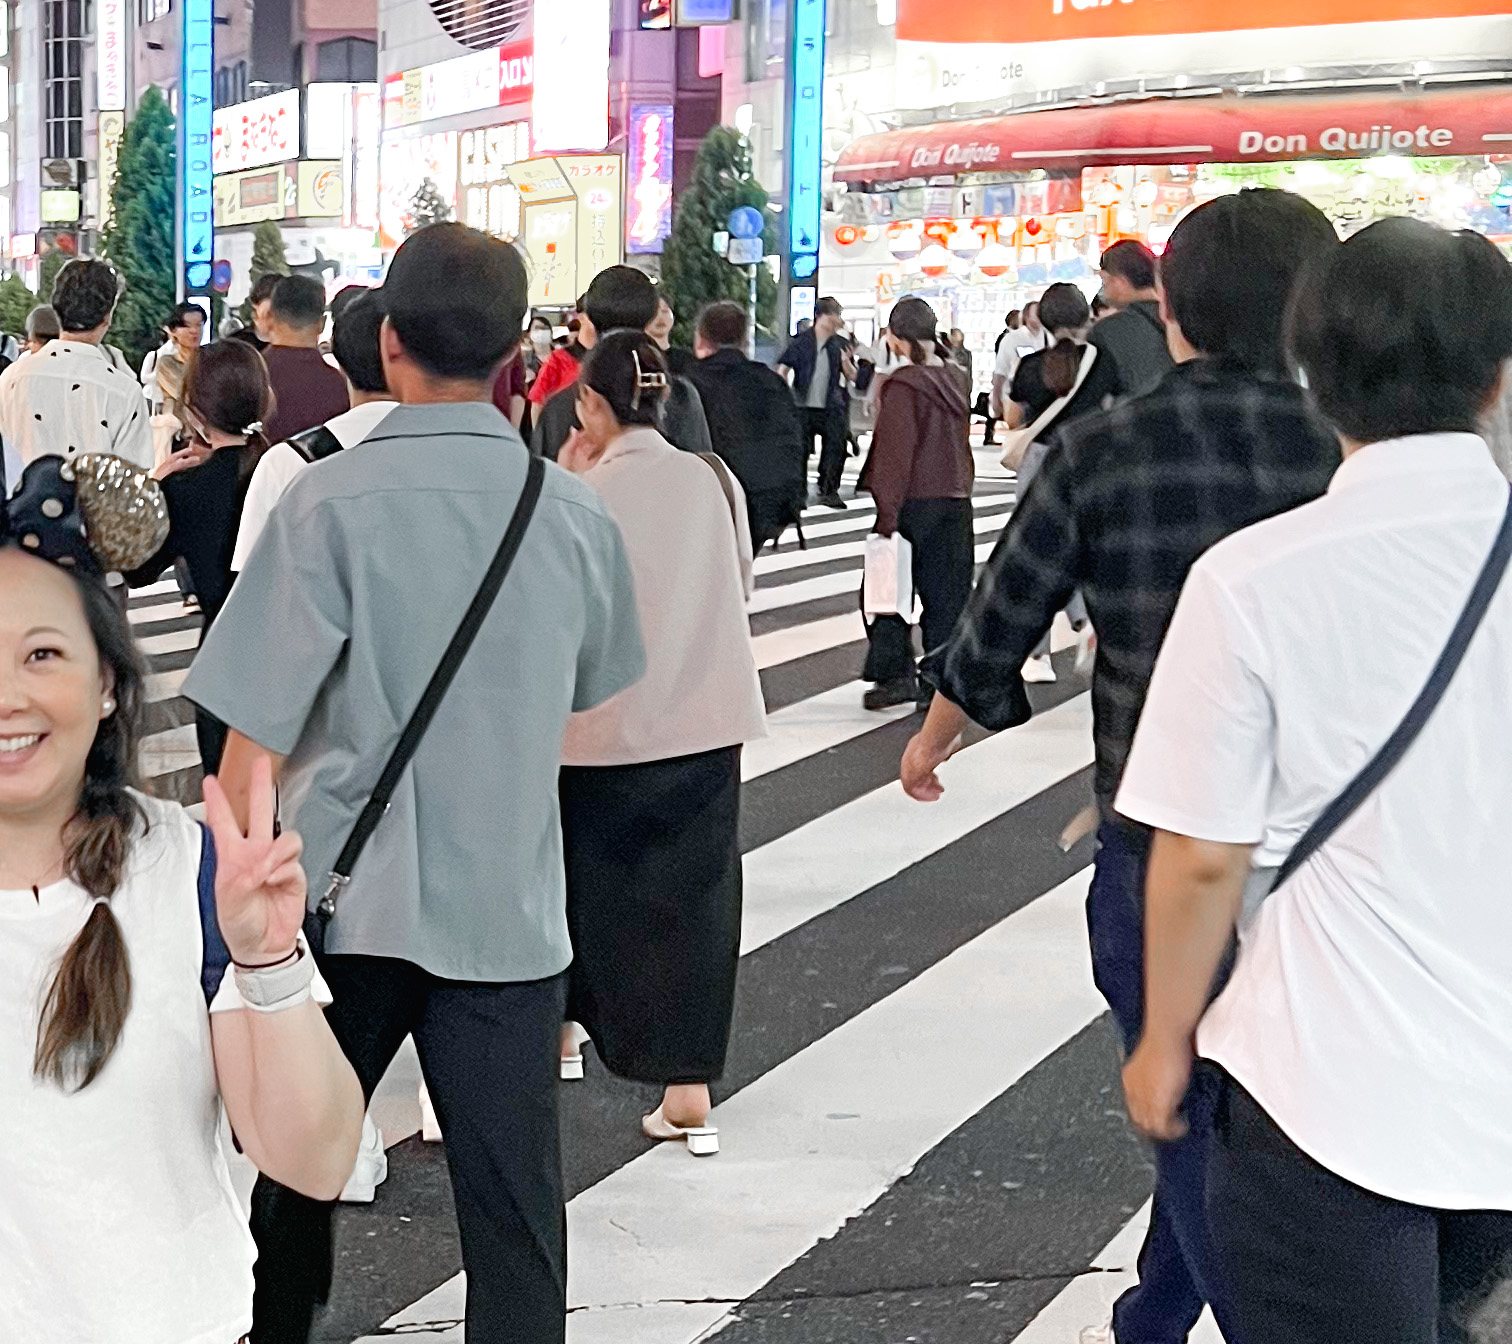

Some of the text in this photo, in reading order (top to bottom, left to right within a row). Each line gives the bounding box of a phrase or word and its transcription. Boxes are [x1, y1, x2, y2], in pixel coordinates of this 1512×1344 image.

[1238, 123, 1454, 155] Don Quijote
[911, 143, 944, 168] Don
[190, 132, 209, 224] ROAD
[568, 164, 616, 177] カラオケ
